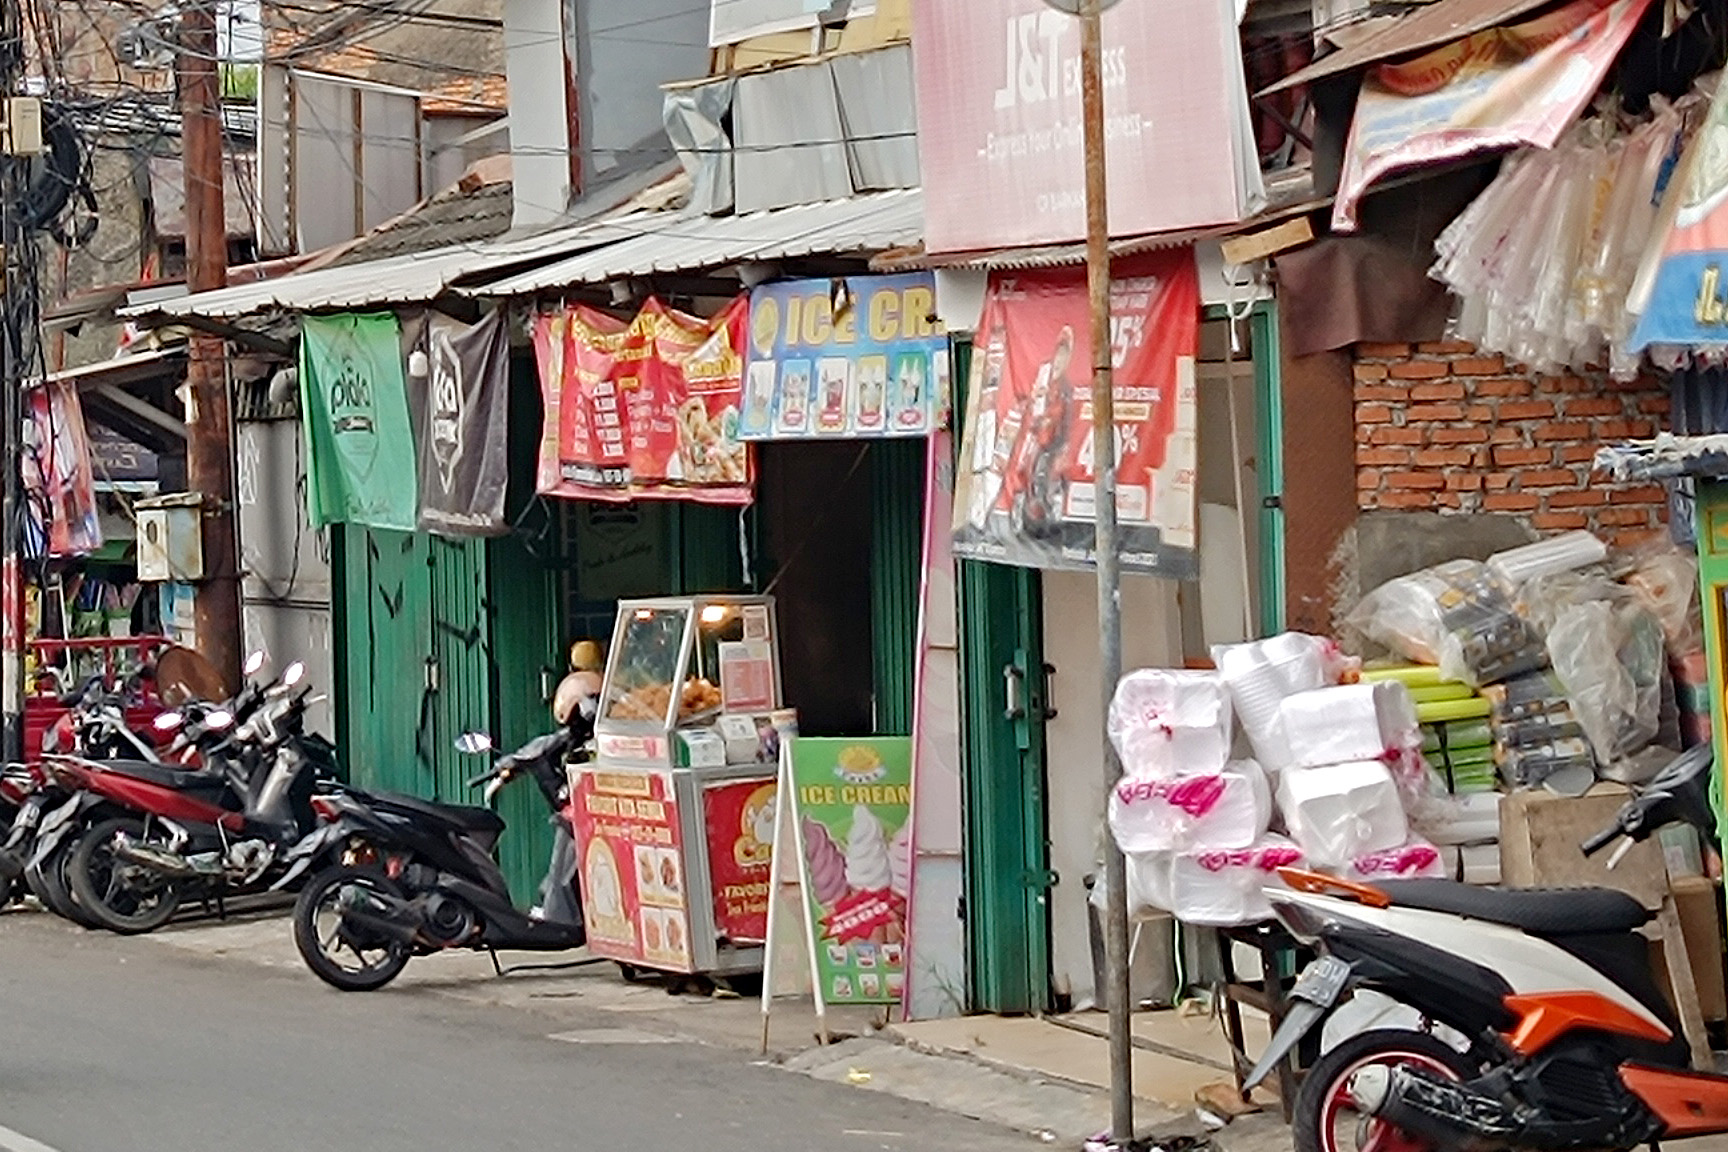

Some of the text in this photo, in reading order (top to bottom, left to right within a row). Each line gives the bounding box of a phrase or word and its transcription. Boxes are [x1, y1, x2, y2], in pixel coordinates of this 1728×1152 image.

[994, 9, 1071, 109] J&T
[785, 295, 859, 346] ICE
[801, 786, 835, 805] ICE
